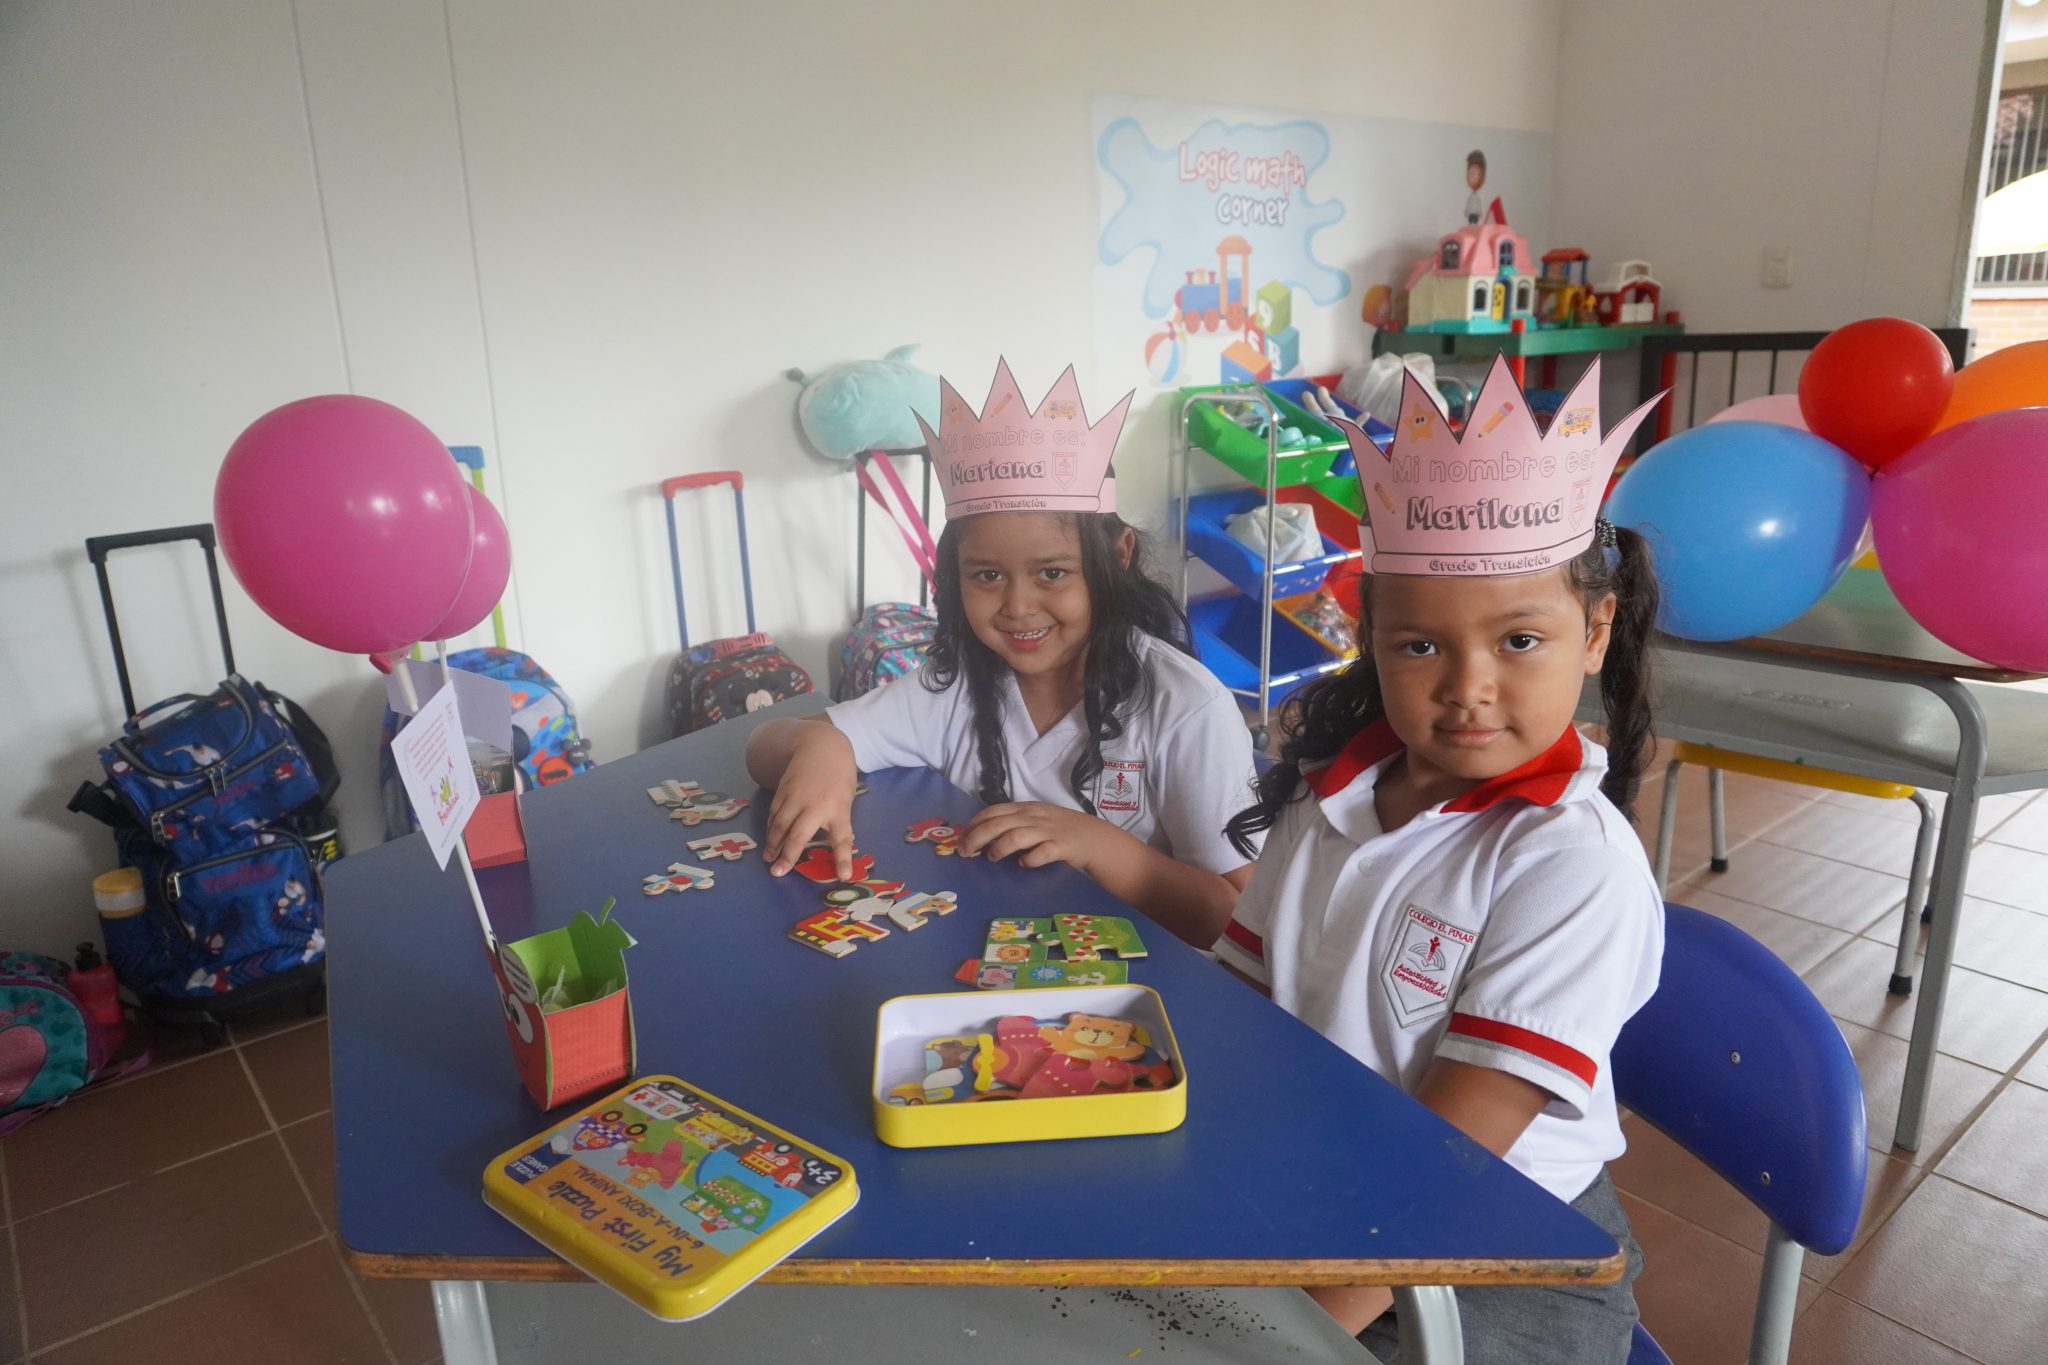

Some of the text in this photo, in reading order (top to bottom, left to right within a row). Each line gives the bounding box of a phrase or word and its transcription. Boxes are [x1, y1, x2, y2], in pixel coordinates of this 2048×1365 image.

[1178, 141, 1307, 195] Logic math
[961, 425, 1045, 451] nombre
[1053, 429, 1087, 447] es:
[950, 459, 1046, 486] Mariana
[1391, 448, 1597, 483] Mi nombre es:
[965, 501, 992, 513] Grado
[1406, 495, 1564, 531] Mariluna
[1429, 553, 1551, 572] Grado Transición
[1409, 909, 1438, 928] COLEGIO
[1448, 929, 1474, 943] PINAR
[510, 1161, 538, 1180] PUZZLE
[522, 1155, 550, 1173] GAMES
[808, 1166, 839, 1185] 3+
[573, 1165, 624, 1197] ANIMAL
[548, 1180, 694, 1277] My First Puzzle
